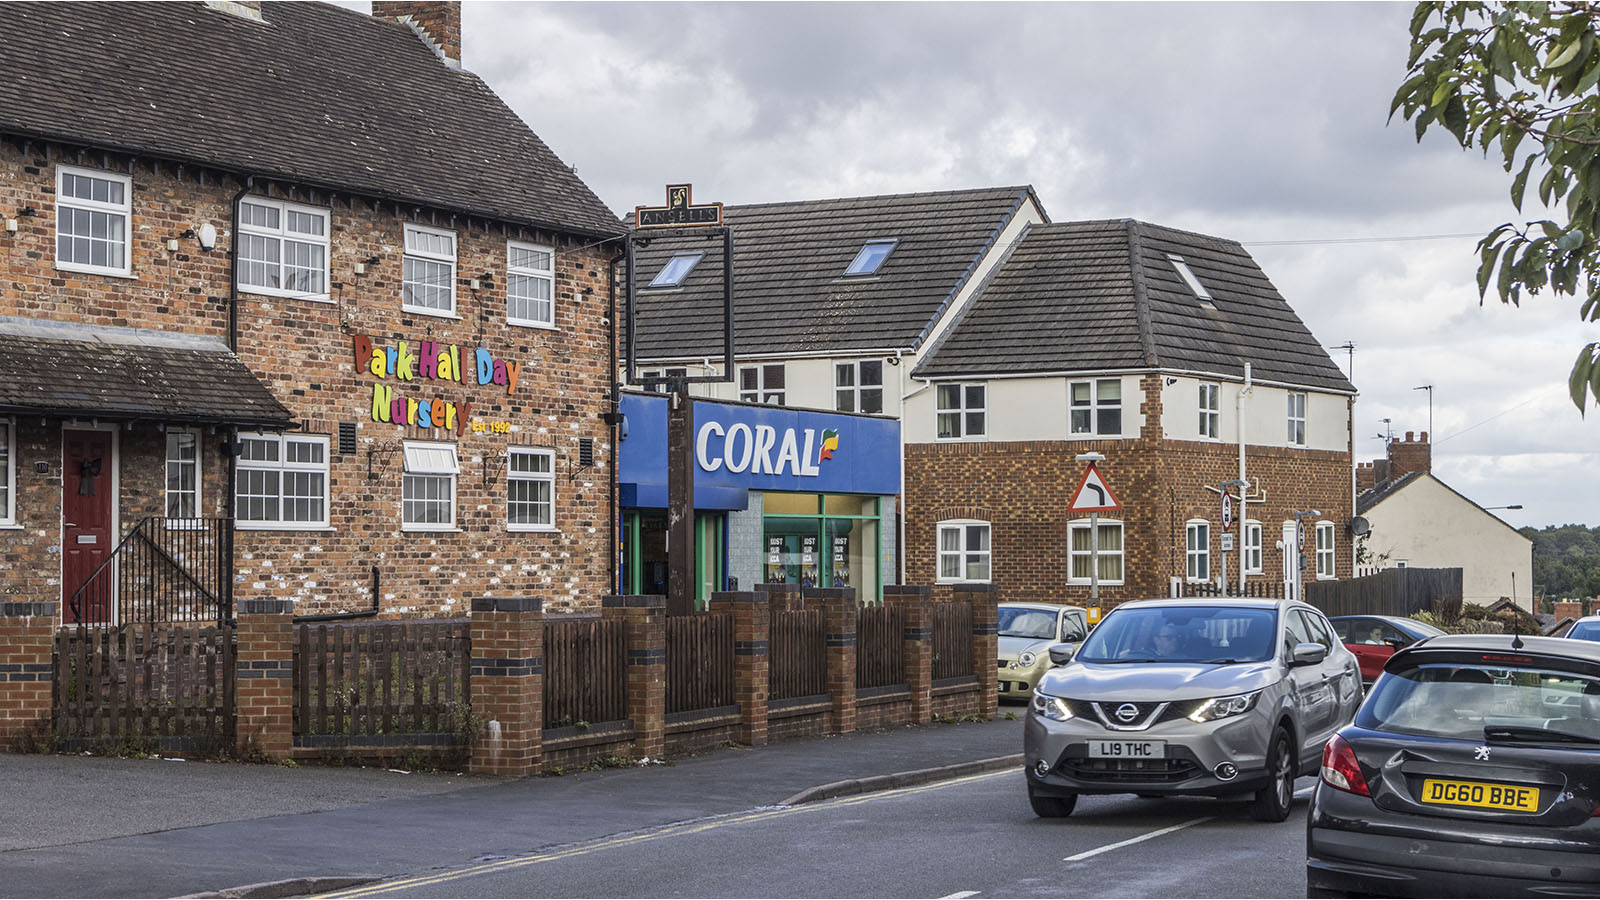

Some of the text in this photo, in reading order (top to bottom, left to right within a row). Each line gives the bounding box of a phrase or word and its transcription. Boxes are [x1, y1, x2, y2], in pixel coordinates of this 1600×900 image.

[354, 334, 521, 395] Park Hall Day
[371, 383, 472, 437] Nursery
[472, 420, 511, 433] Est 1992
[696, 421, 820, 477] CORAL
[1101, 743, 1151, 756] L19 THC
[1431, 783, 1530, 808] DG60 BBE
